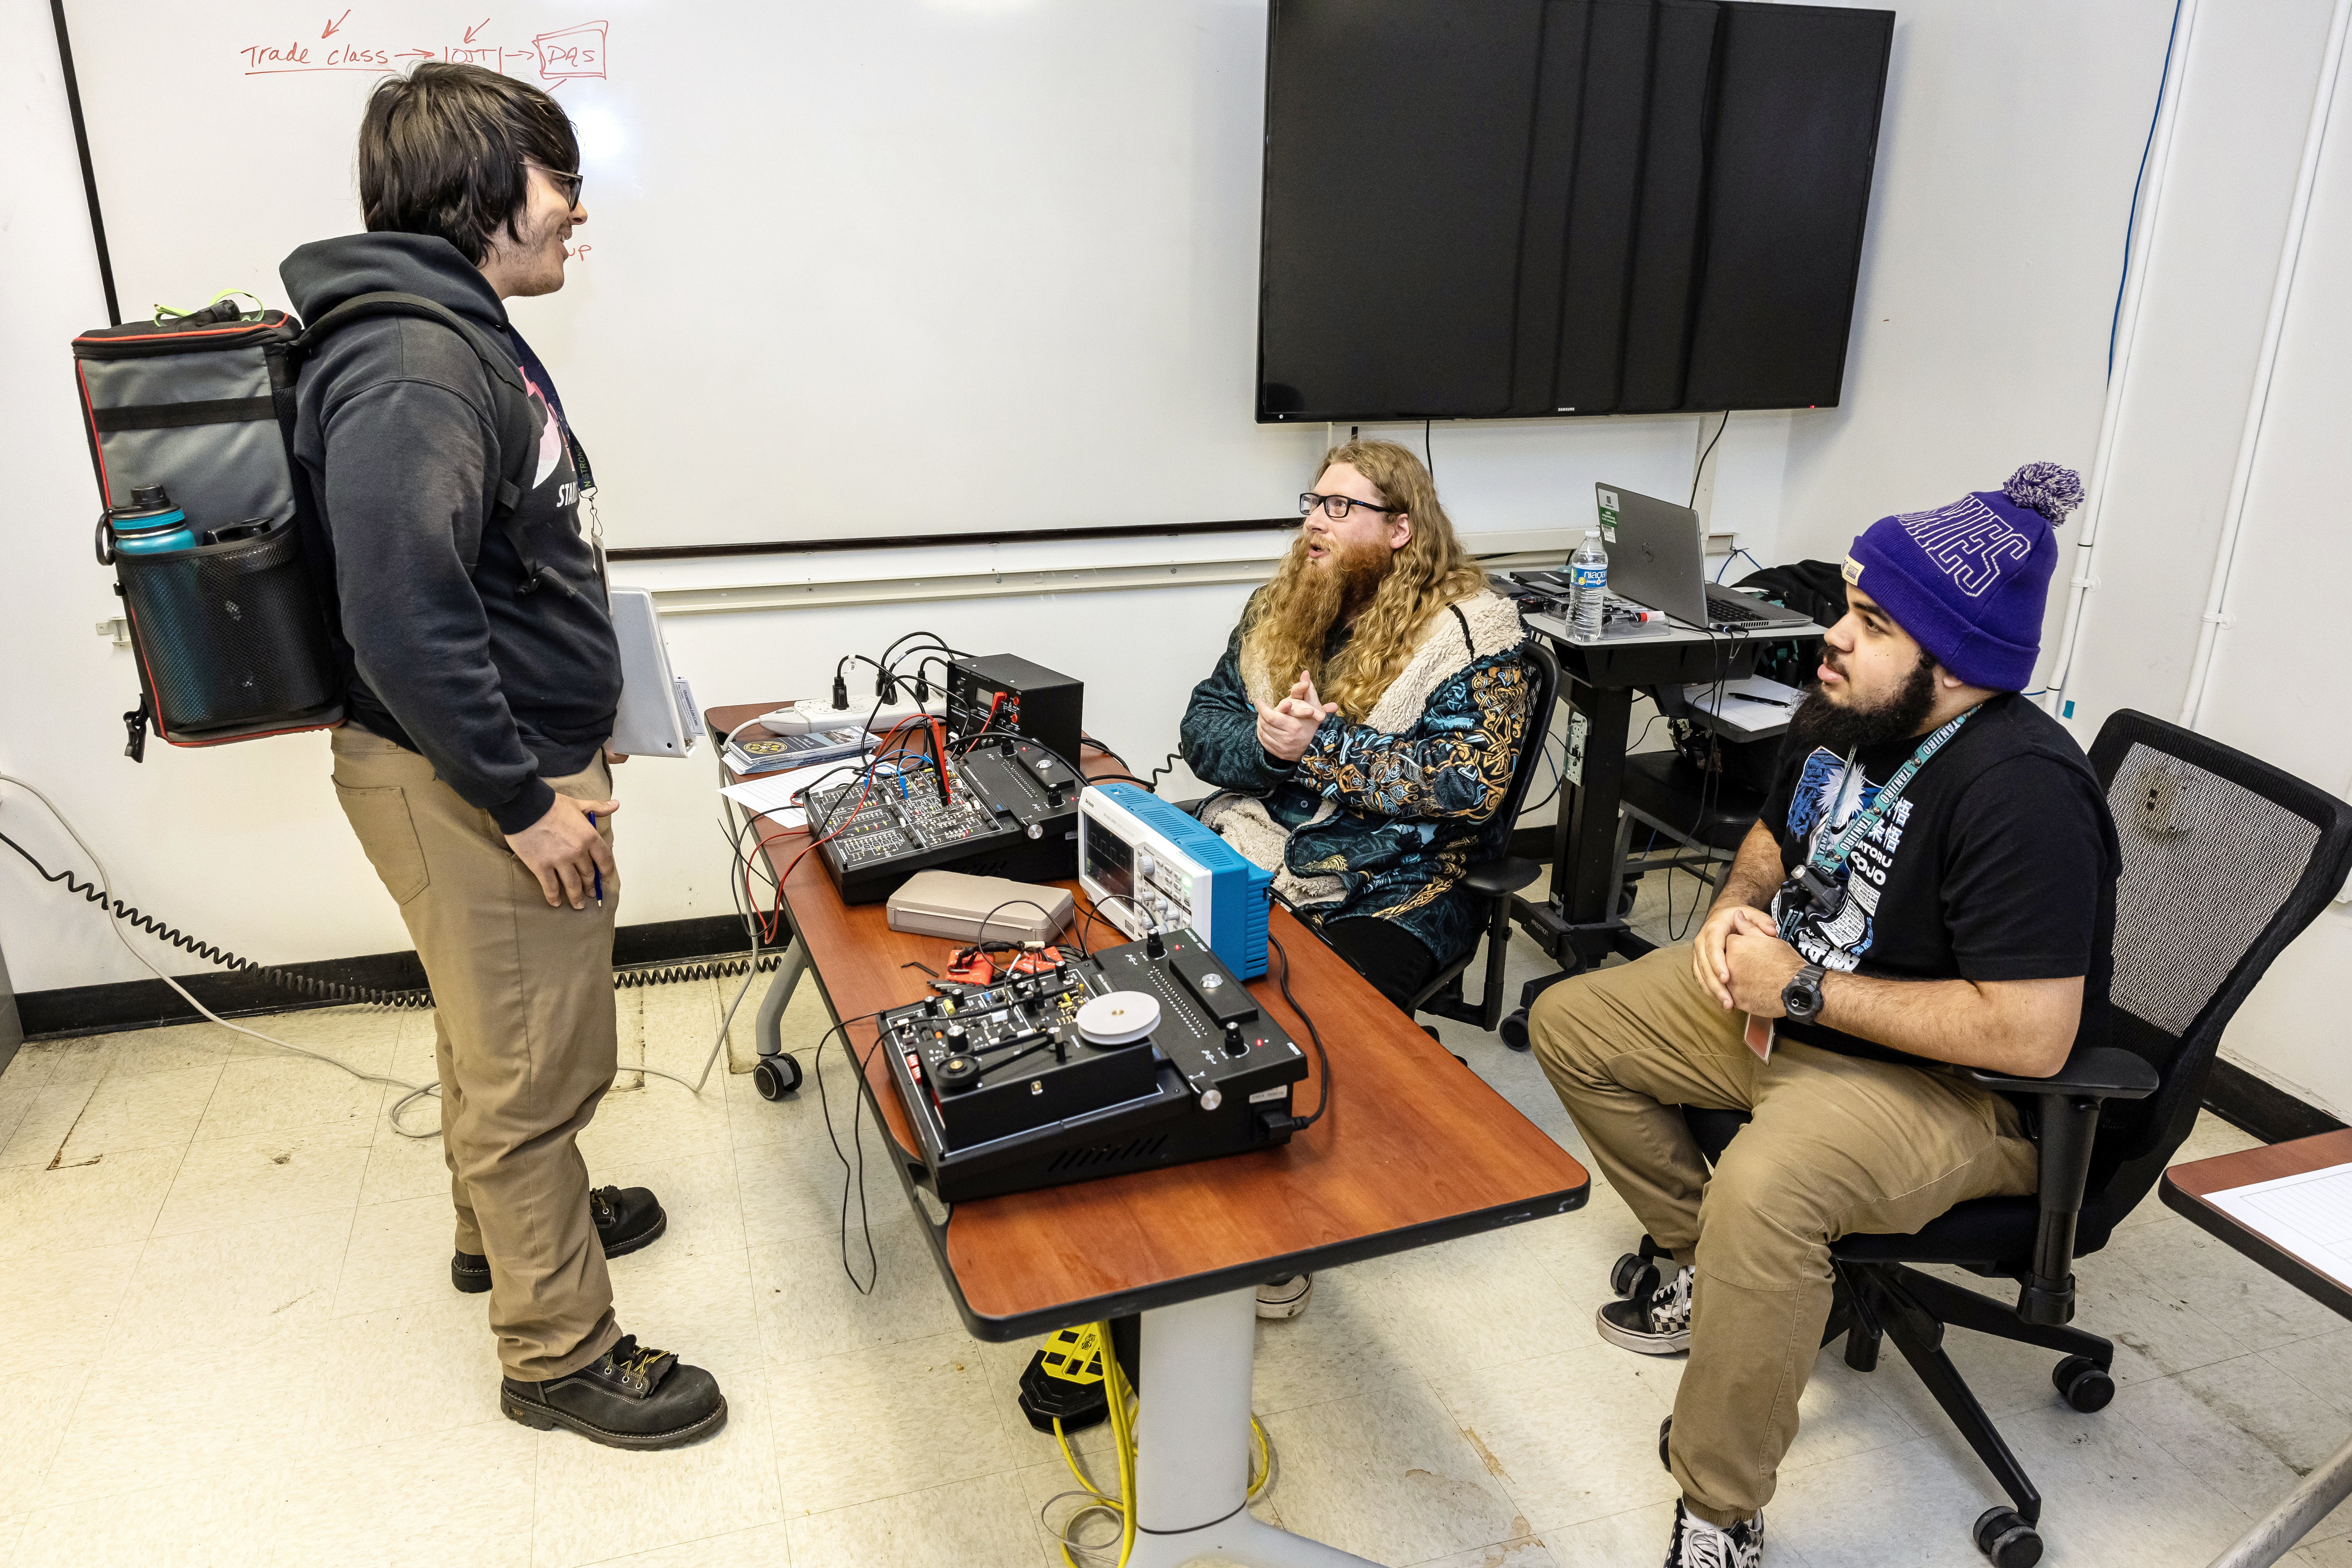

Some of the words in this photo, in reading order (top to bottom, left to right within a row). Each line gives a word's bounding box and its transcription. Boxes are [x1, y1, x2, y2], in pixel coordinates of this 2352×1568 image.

[241, 42, 311, 67] Trade
[327, 44, 388, 65] class
[1923, 720, 1961, 755] TANJIRO
[1880, 767, 1912, 804] TANJIRO
[1817, 816, 1833, 855] TANJIRO
[1840, 817, 1872, 850] TANJIRO
[1851, 851, 1886, 885] GOJO
